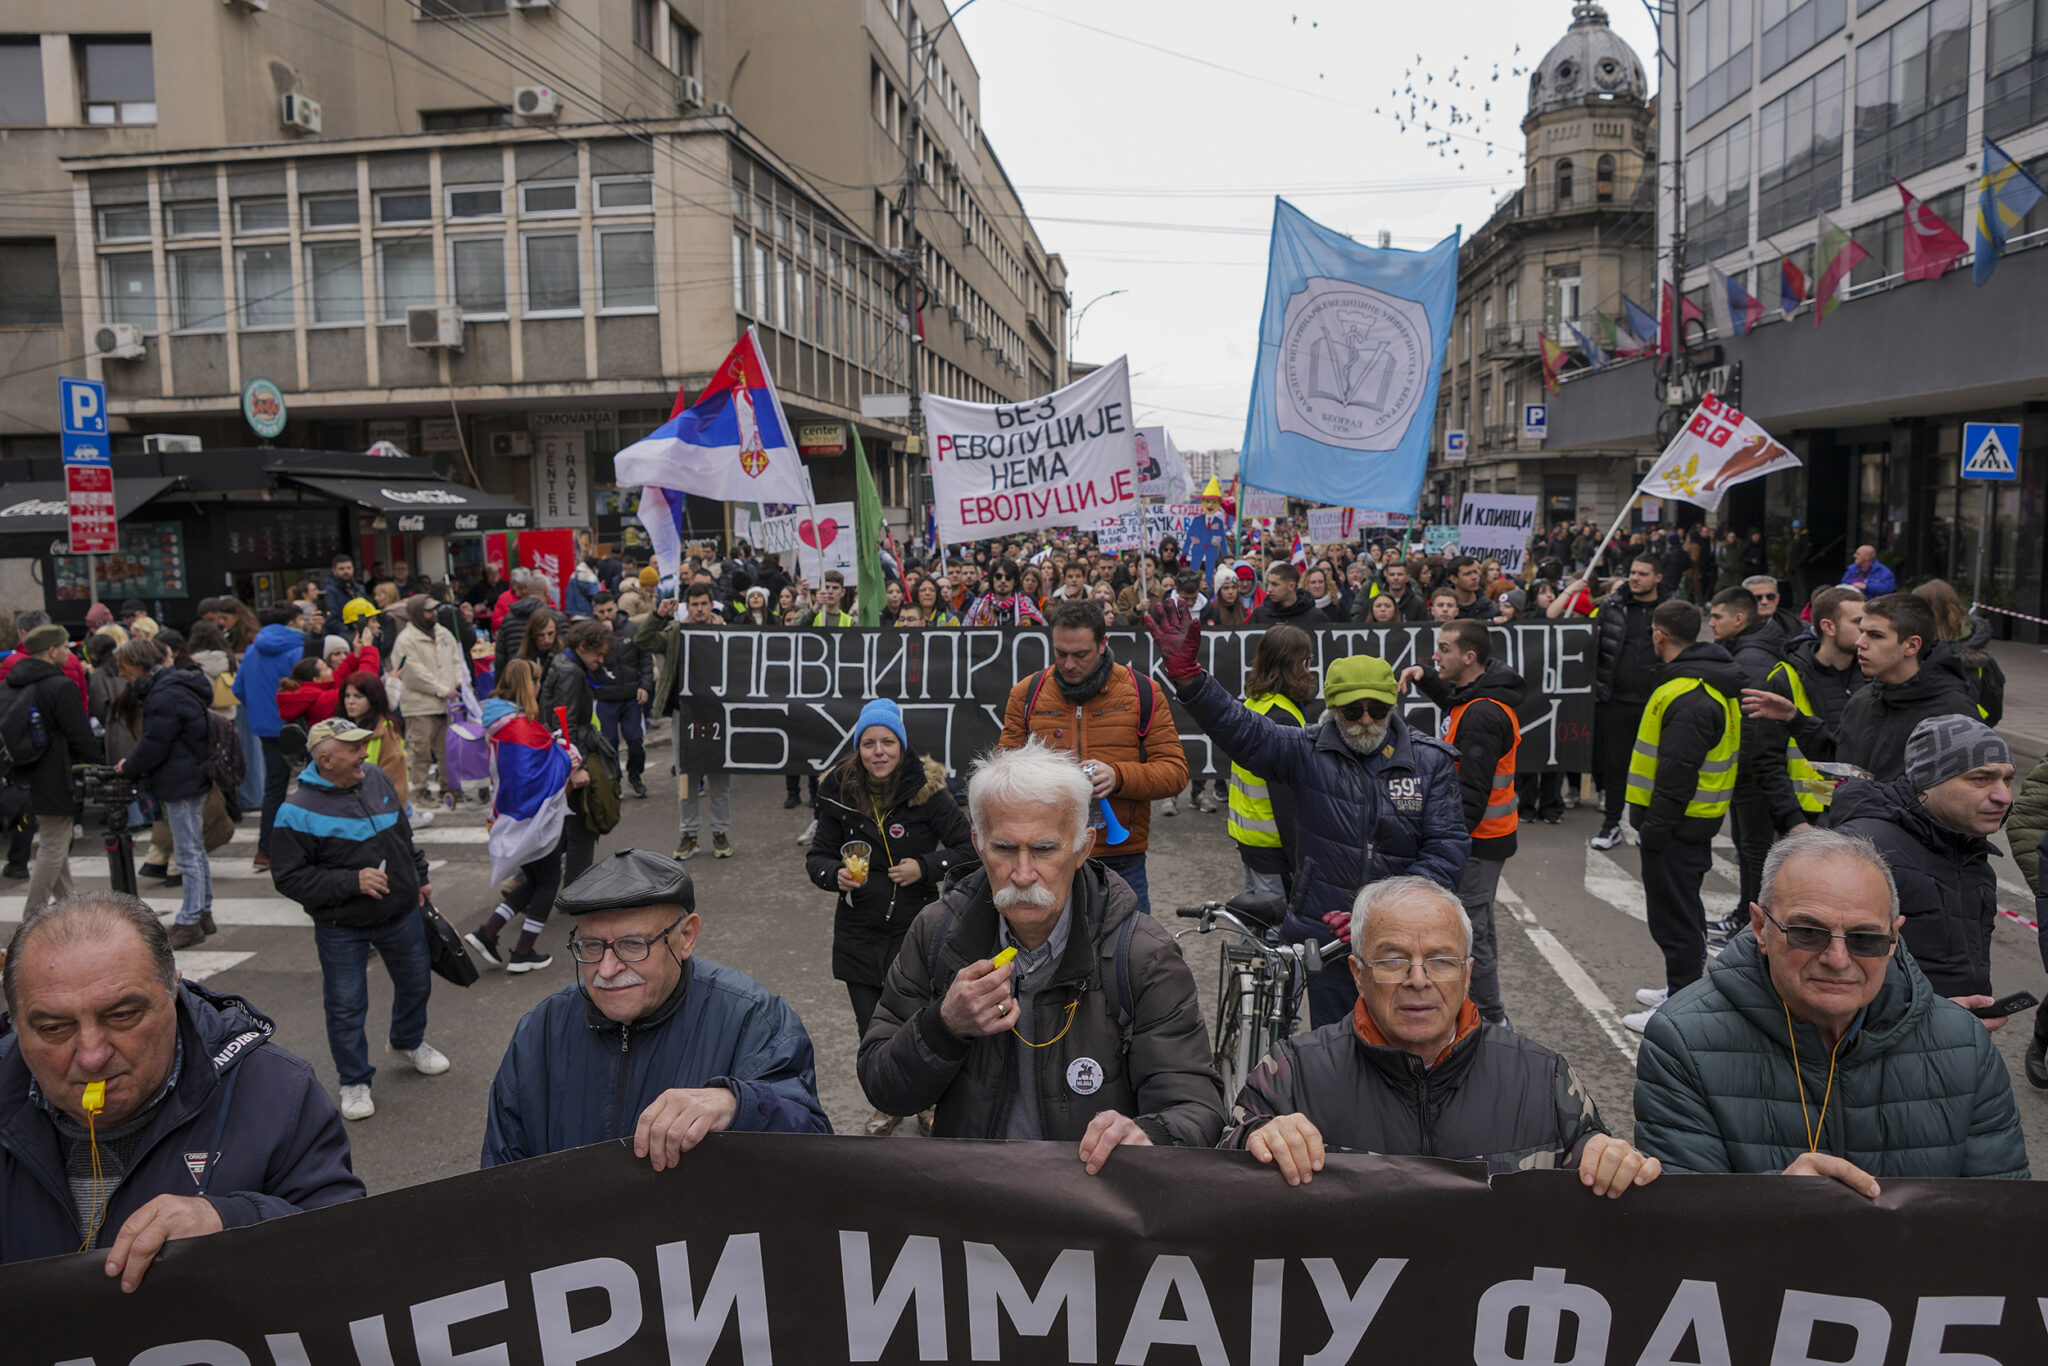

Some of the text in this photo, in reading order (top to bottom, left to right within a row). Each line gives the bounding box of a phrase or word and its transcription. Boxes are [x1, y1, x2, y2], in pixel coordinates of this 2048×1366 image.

[71, 385, 104, 430] P 3
[995, 396, 1056, 429] БЕЗ
[1530, 408, 1544, 424] P
[803, 425, 837, 436] center
[937, 402, 1125, 461] РЕВОЛУЦИЈЕ
[546, 443, 558, 516] CENTER
[565, 442, 578, 516] TRAVEL
[991, 452, 1069, 490] НЕМА
[960, 469, 1134, 525] ЕВОЛУЦИЈЕ
[1462, 503, 1473, 525] И
[679, 630, 910, 699] ГЛАВНИ
[1557, 722, 1591, 743] 034
[212, 1031, 260, 1069] ORIGIN
[838, 1230, 1410, 1366] ИМАЈУ
[1473, 1266, 2048, 1366] ФАРБ
